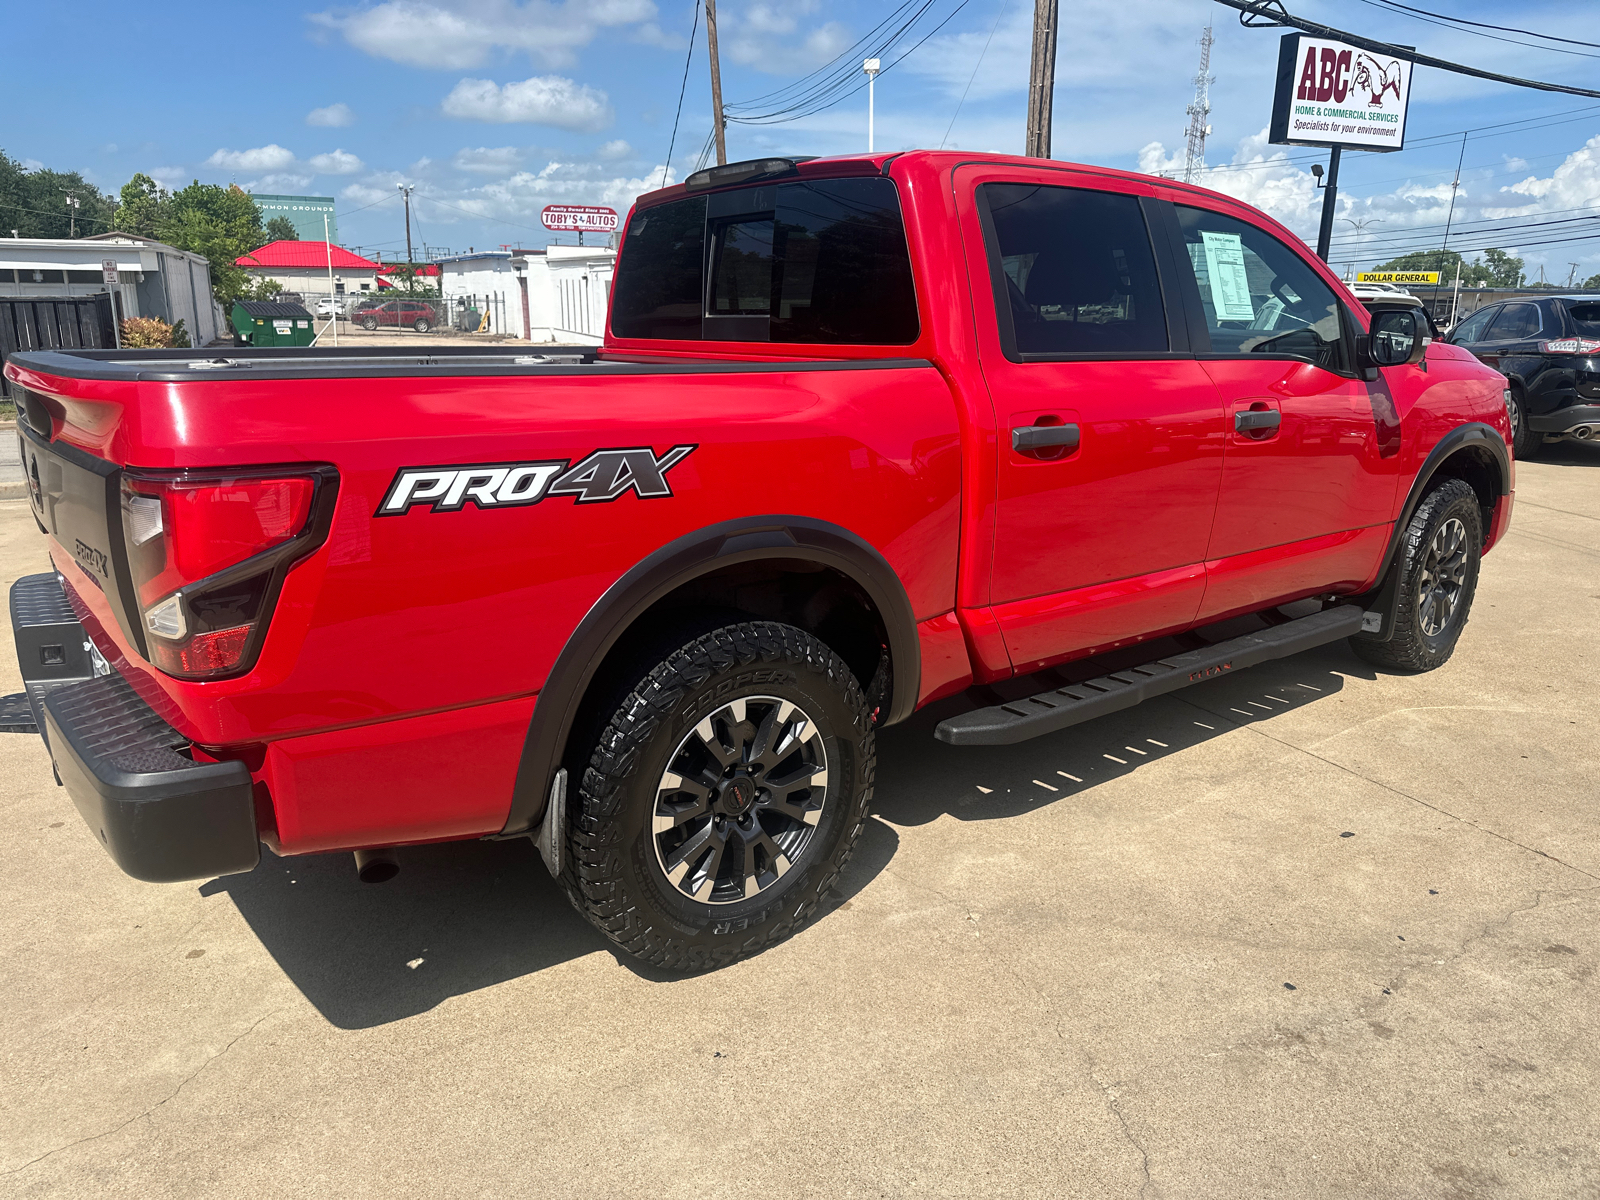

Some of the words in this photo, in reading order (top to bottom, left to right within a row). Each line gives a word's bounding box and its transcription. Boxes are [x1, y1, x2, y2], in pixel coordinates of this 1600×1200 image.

[1297, 46, 1353, 104] ABC
[1295, 105, 1316, 116] HOME
[1316, 107, 1322, 116] &
[1323, 107, 1367, 120] COMMERCIAL
[1368, 111, 1399, 123] SERVICES
[1294, 118, 1330, 131] Specialists
[1330, 121, 1341, 132] for
[1341, 124, 1356, 134] your
[1356, 124, 1397, 137] environment
[544, 213, 578, 225] TOBY'S
[585, 215, 616, 226] AUTOS
[1363, 274, 1393, 282] DOLLAR
[1395, 274, 1430, 282] GENERAL
[1187, 661, 1233, 681] TITAN
[681, 668, 790, 724] COOPER
